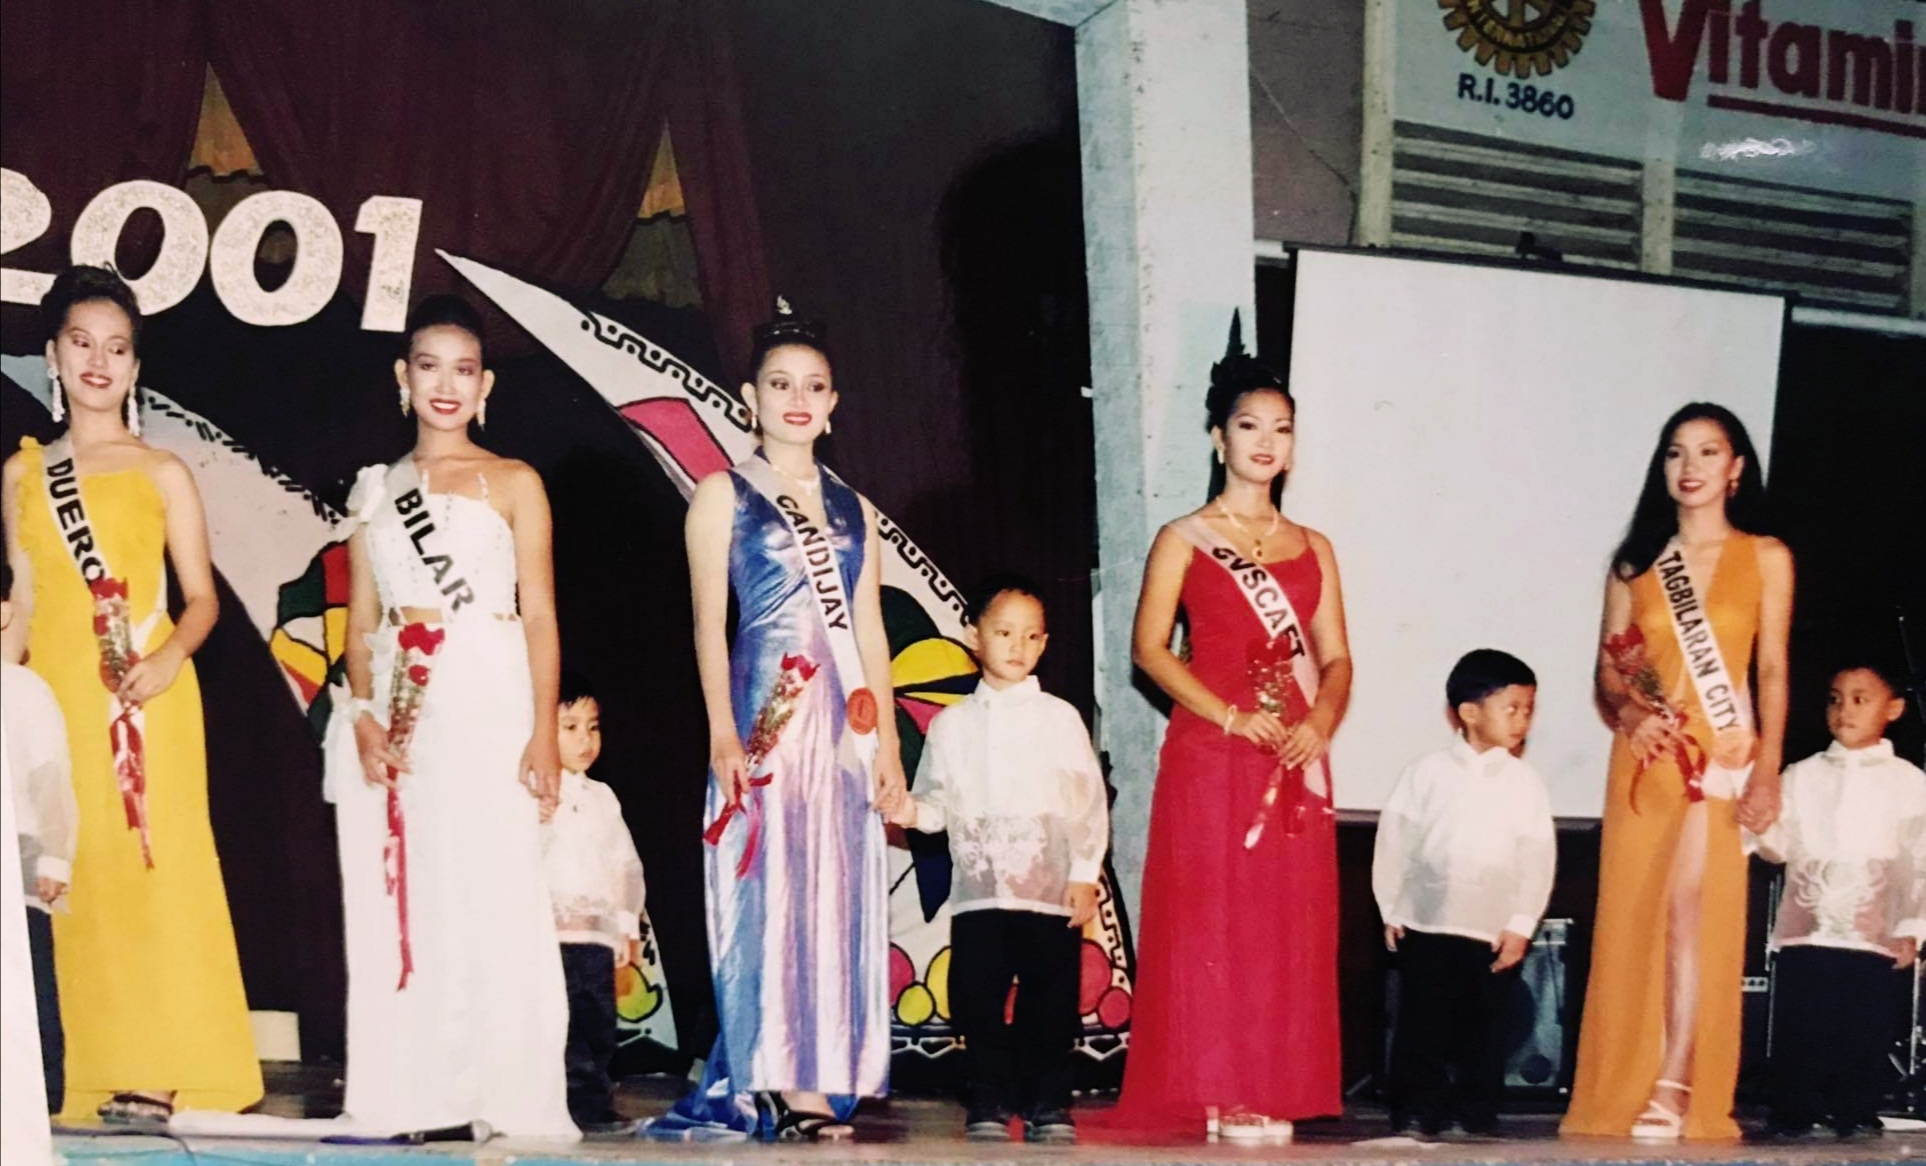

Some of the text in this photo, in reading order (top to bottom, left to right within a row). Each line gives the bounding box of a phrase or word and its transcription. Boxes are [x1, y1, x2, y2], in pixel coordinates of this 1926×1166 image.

[1458, 72, 1575, 120] R.I. 3860
[1637, 0, 1926, 116] Vitami
[46, 457, 105, 586] DUERO
[394, 487, 475, 614] BILAR
[776, 493, 849, 631] CANDIJAY
[1657, 550, 1741, 732] TAGBILARAN CITY
